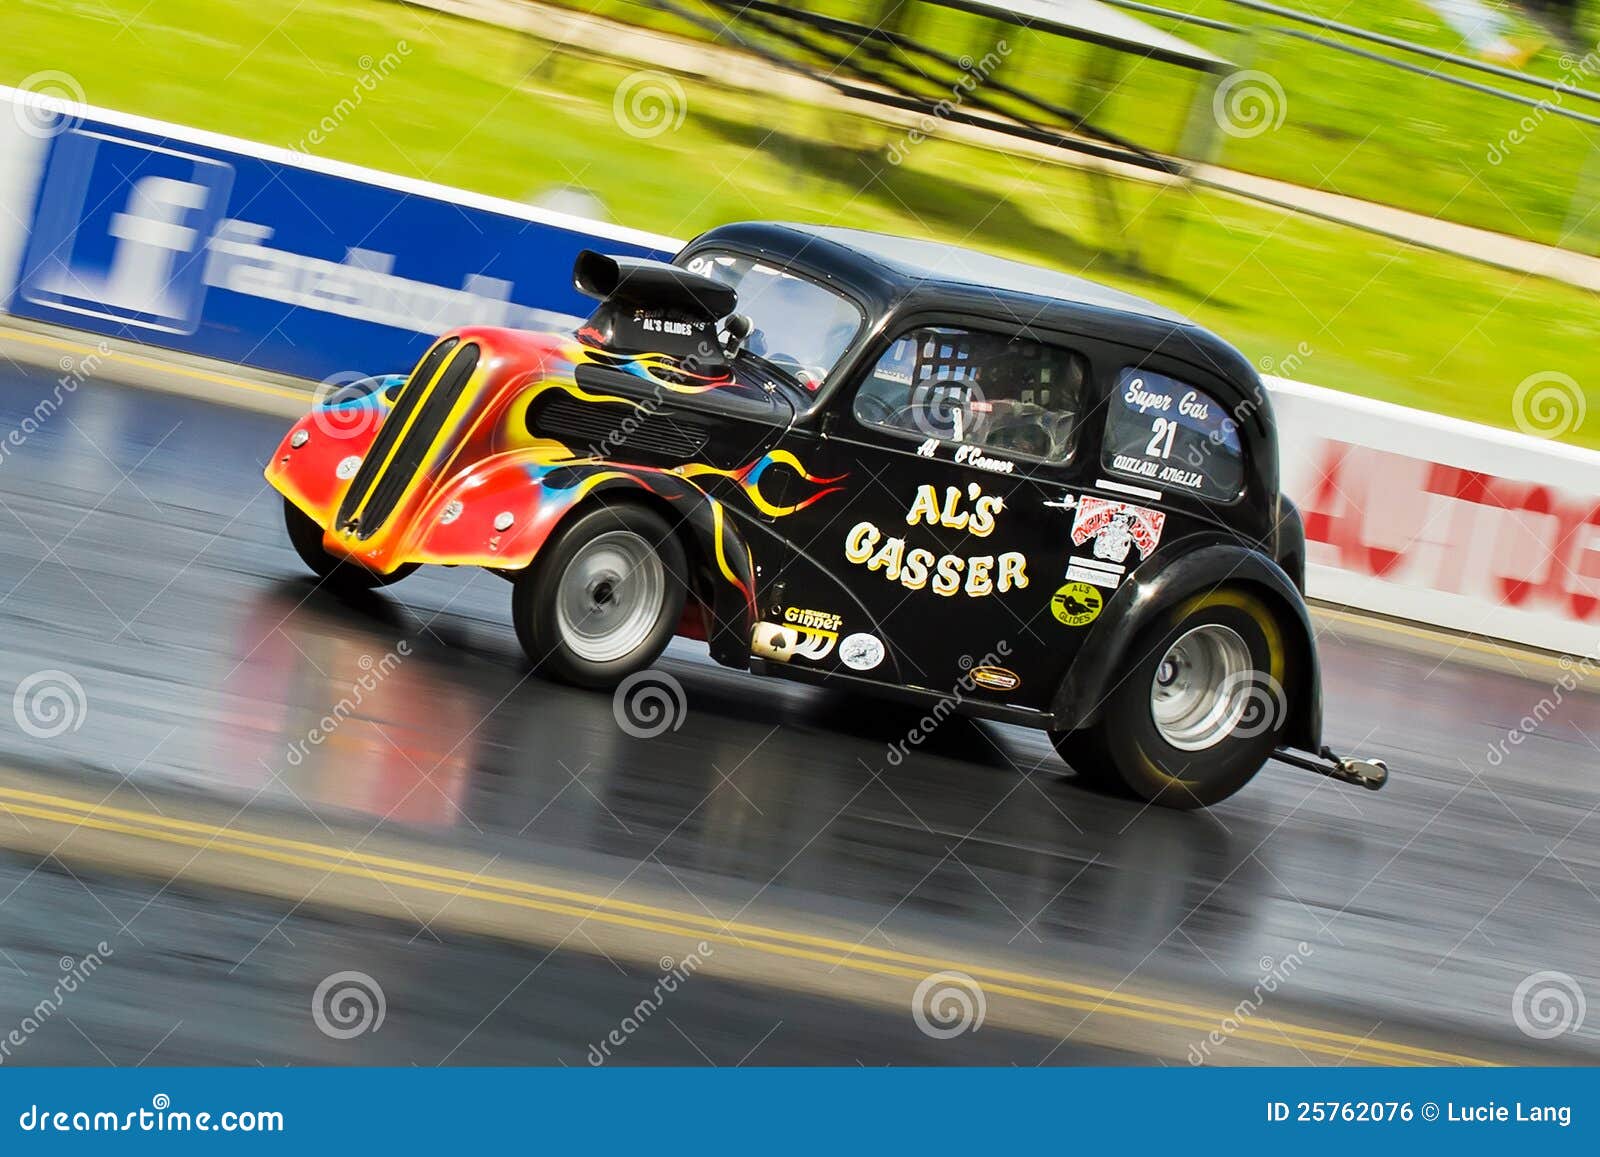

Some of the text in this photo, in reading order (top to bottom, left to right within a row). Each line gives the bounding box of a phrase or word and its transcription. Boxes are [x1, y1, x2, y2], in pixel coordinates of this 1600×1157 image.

[643, 319, 662, 332] AL'S
[664, 321, 692, 336] GLIDES
[1124, 379, 1209, 420] Super Gas
[917, 438, 941, 458] Al
[1145, 417, 1178, 460] 21
[1158, 466, 1203, 488] ANGLIA
[906, 482, 1004, 537] AL'S
[845, 521, 1029, 598] GASSER
[784, 606, 843, 632] Ginner
[1058, 611, 1091, 625] GLIDES
